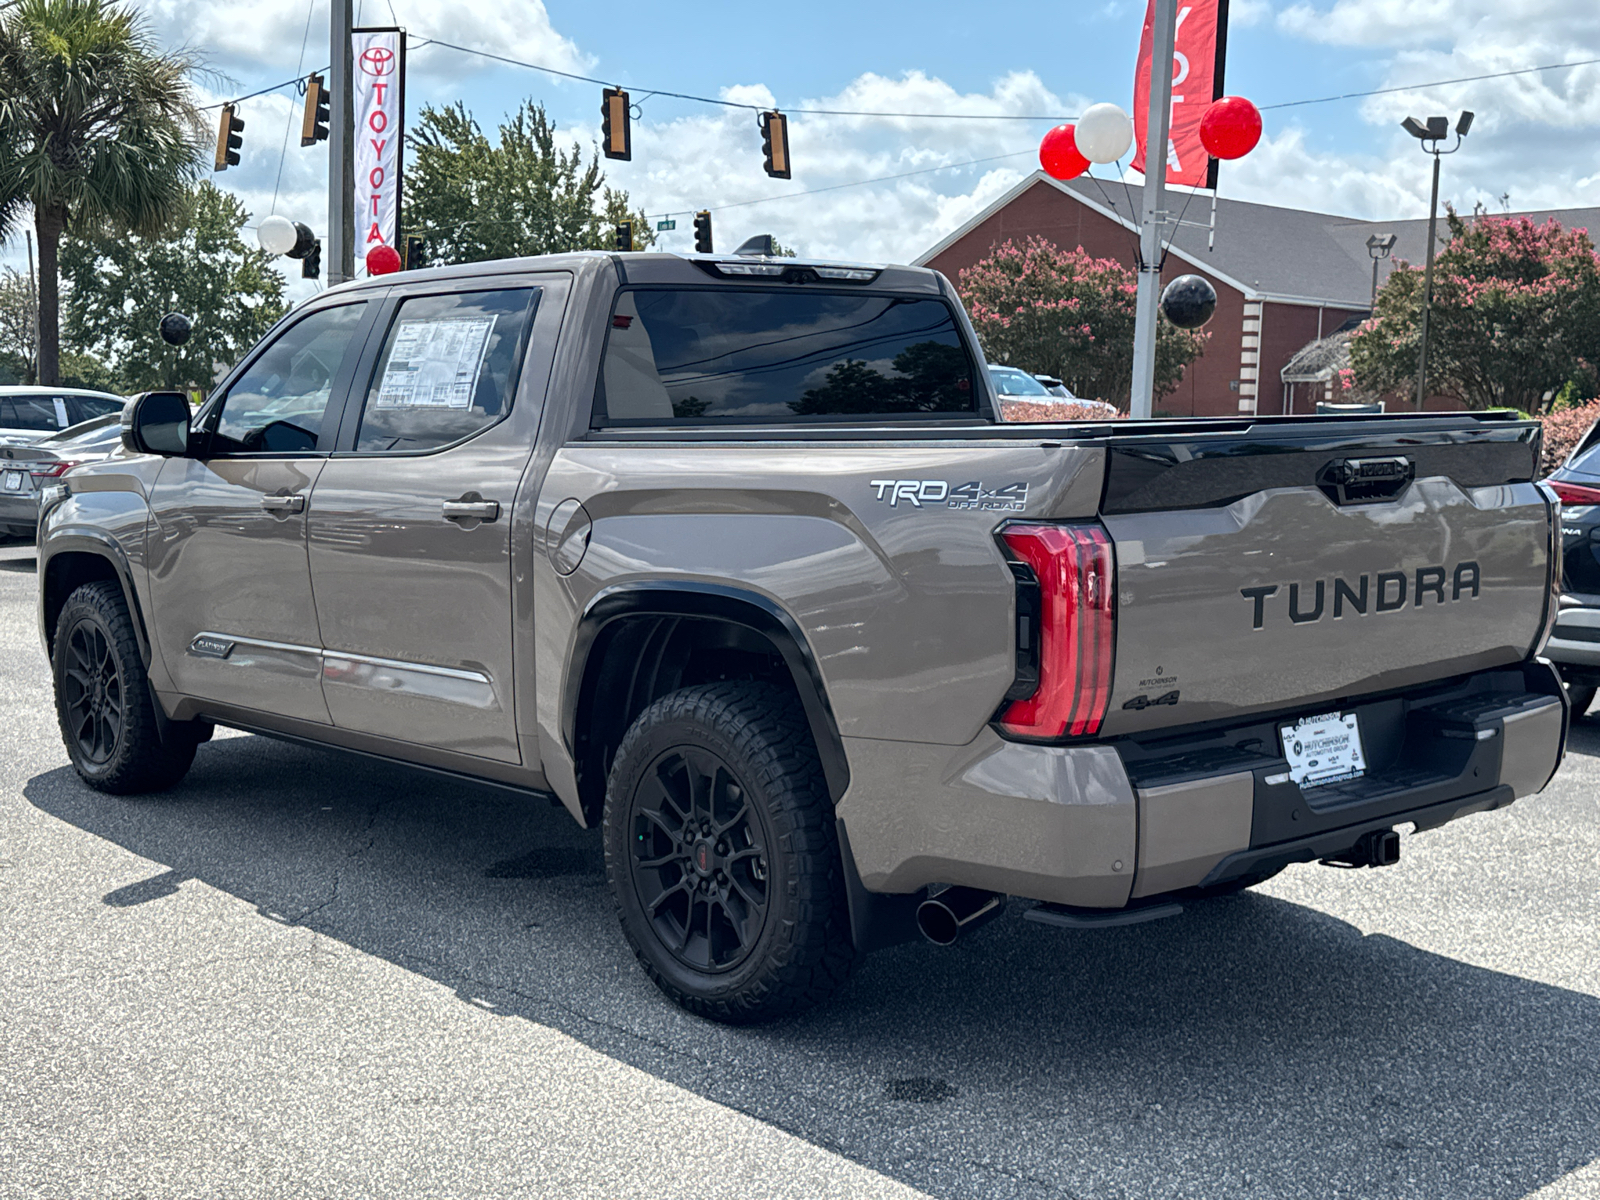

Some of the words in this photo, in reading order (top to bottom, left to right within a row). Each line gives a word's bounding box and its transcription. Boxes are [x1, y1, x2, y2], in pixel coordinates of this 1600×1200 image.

[366, 83, 388, 244] TOYOTA
[1363, 463, 1394, 475] TOYOTA
[870, 479, 949, 509] TRD
[949, 481, 1029, 503] 4x4
[947, 501, 978, 510] OFF
[980, 502, 1026, 512] ROAD
[1240, 561, 1481, 630] TUNDRA
[198, 640, 226, 651] PLATINUM
[1139, 676, 1178, 687] HUTCHINSON
[1303, 734, 1350, 752] HUTCHINSON
[1306, 747, 1333, 758] AUTOMOTIVE
[1333, 744, 1348, 753] GROUP
